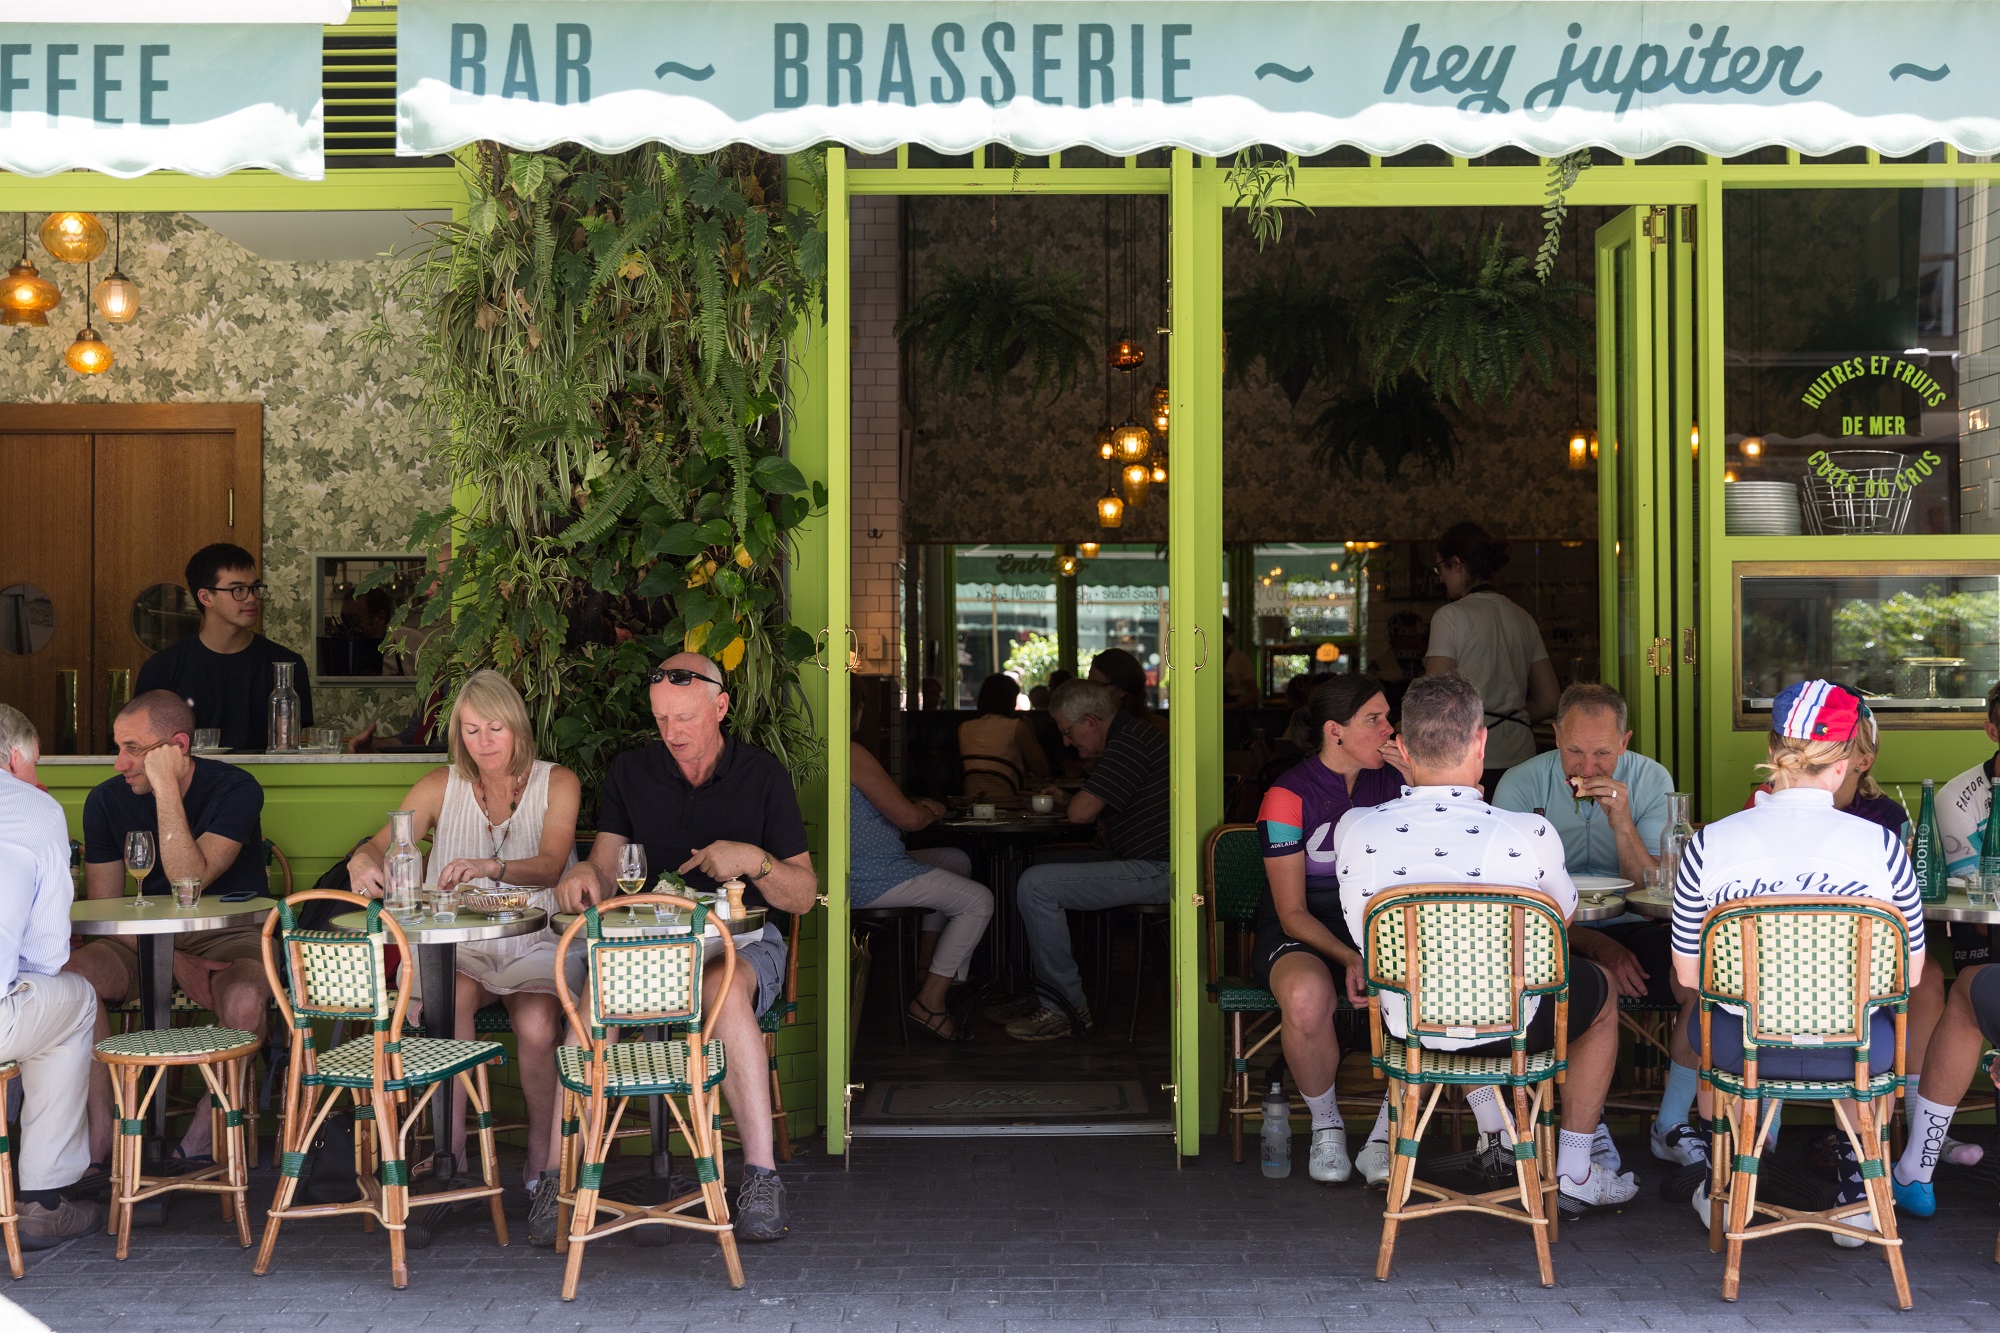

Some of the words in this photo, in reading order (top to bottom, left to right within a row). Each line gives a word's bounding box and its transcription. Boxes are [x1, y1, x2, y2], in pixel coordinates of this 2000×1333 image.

[0, 44, 170, 129] FFEE
[450, 23, 592, 106] BAR
[774, 21, 1193, 109] BRASSERIE
[1383, 23, 1516, 122] hey
[1523, 22, 1822, 123] jupiter
[1802, 357, 1865, 409] HUITRES
[1870, 356, 1890, 375] ET
[1892, 360, 1946, 407] FRUITS
[1842, 416, 1863, 435] DE
[1869, 416, 1906, 435] MER
[1807, 450, 1857, 494] CUITS
[1865, 479, 1889, 498] OU
[1895, 450, 1942, 493] CRUS
[1956, 776, 1984, 812] FACTOR
[1270, 840, 1299, 849] ADELAIDE
[1707, 877, 1787, 908] Hope
[1796, 871, 1874, 898] Vall
